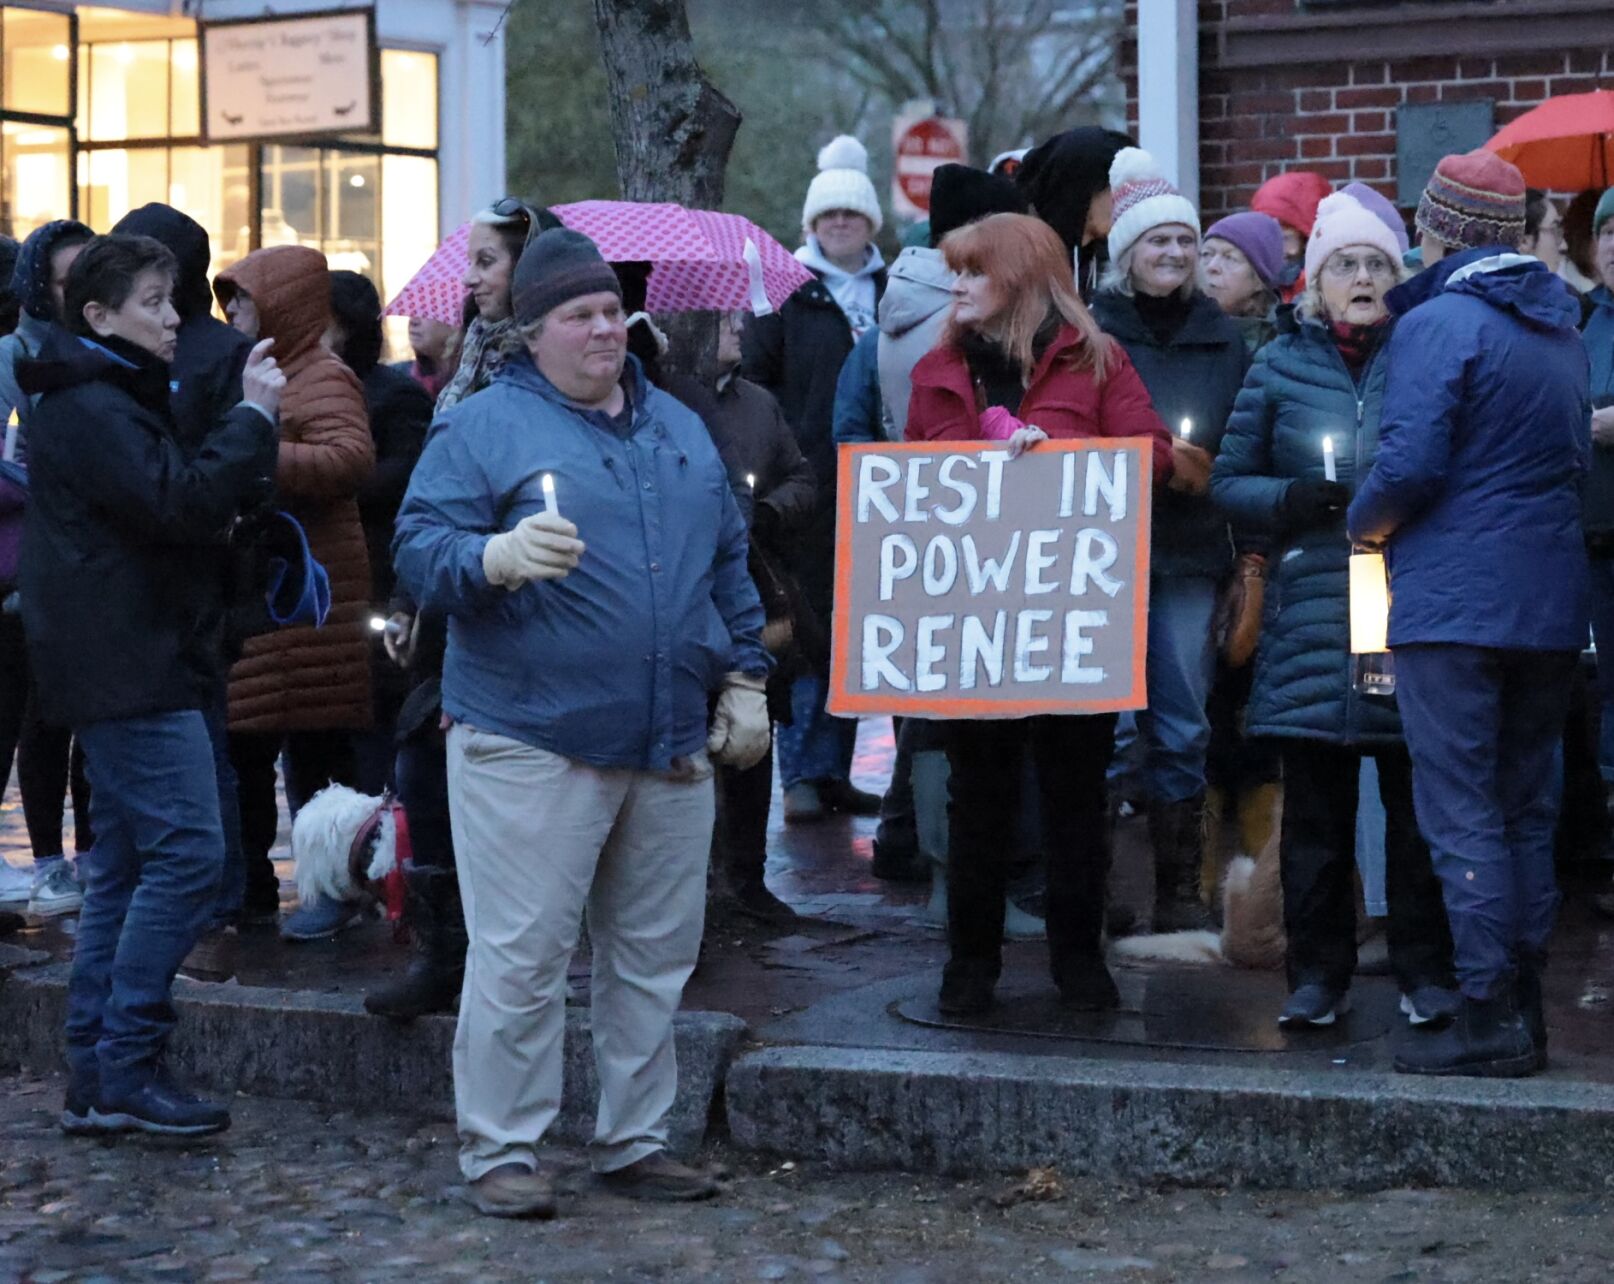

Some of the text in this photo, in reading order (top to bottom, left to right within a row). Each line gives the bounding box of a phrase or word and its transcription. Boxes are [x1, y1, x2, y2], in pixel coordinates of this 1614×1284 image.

[857, 450, 1127, 526] REST IN
[880, 528, 1124, 600] POWER
[860, 610, 1109, 693] RENEE
